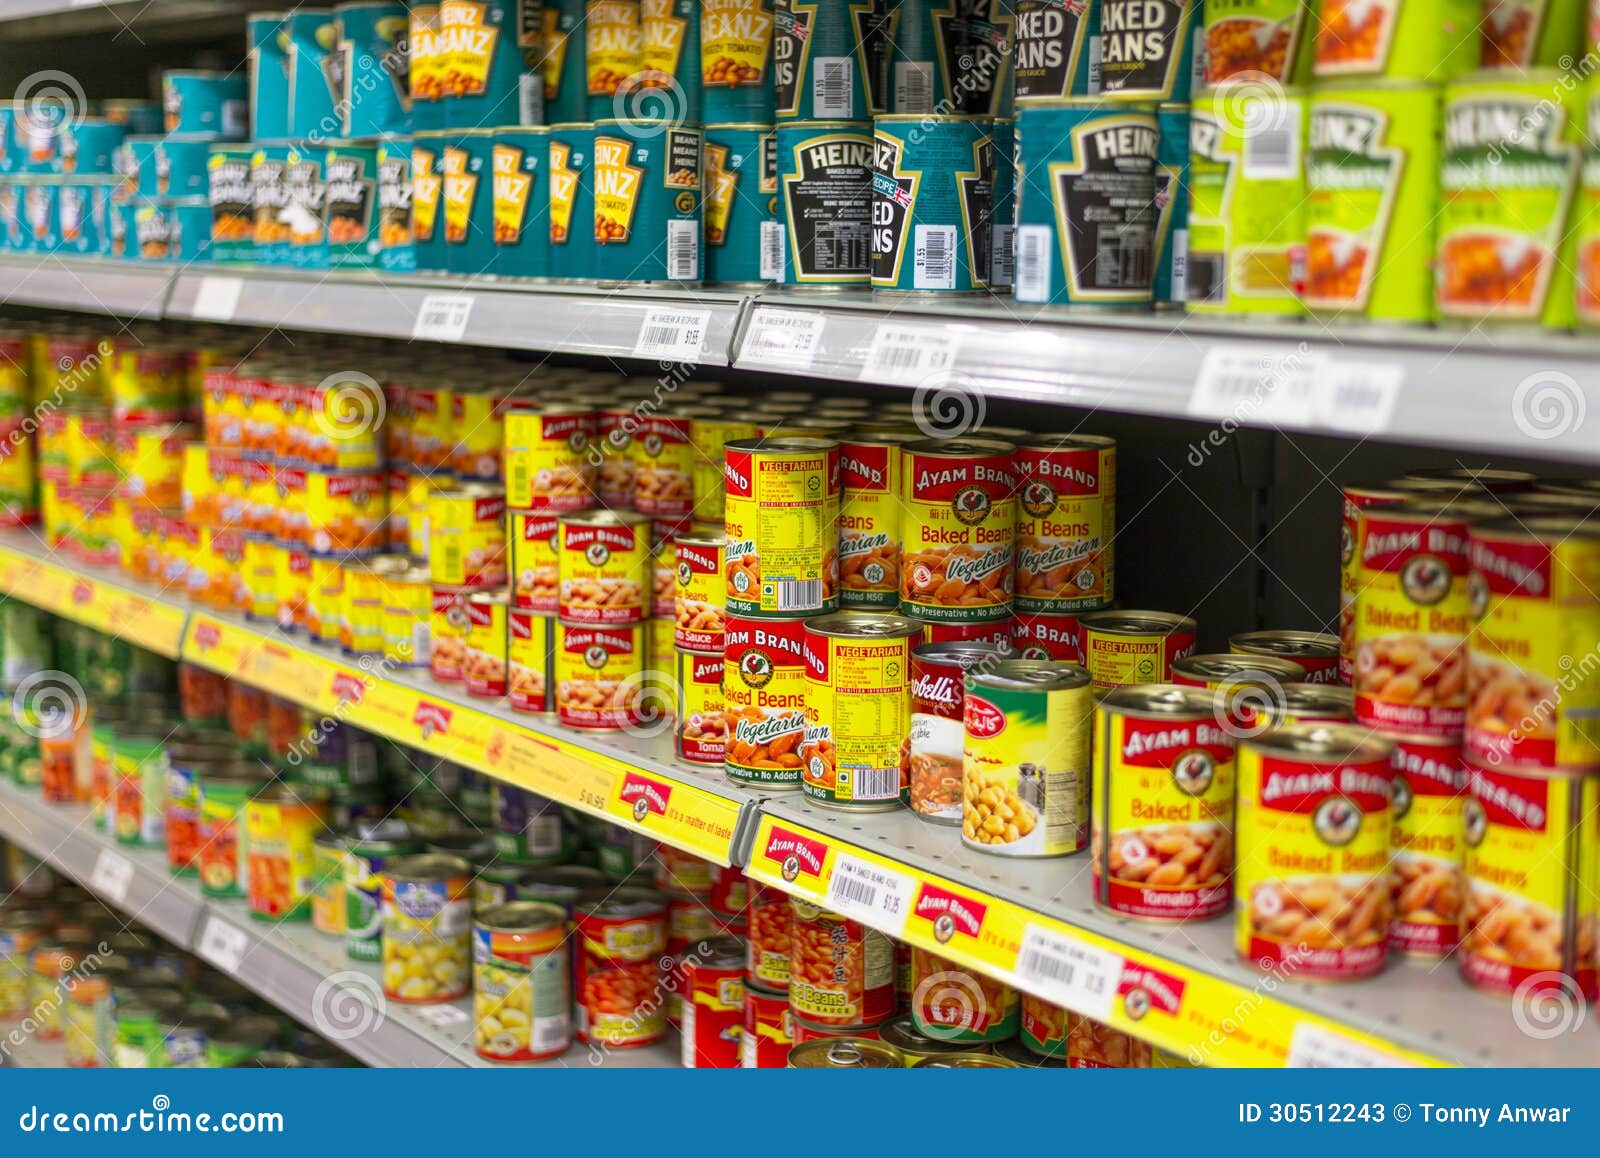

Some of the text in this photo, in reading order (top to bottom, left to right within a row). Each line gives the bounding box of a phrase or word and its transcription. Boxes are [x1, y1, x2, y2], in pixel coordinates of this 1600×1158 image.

[810, 143, 873, 170] HEINZ
[872, 201, 895, 225] ED
[916, 247, 926, 266] $1.55
[763, 461, 822, 472] VEGETARIAN
[1039, 459, 1096, 488] BRAND
[916, 468, 967, 491] AYAM
[921, 525, 1013, 544] Baked Beans
[1041, 520, 1089, 536] Beans
[1016, 536, 1099, 575] Vegetarian
[911, 605, 920, 614] No
[921, 607, 968, 618] Preservative
[977, 609, 988, 617] No
[839, 646, 901, 658] VEGETARIAN
[1095, 640, 1156, 654] VEGETARIAN
[757, 691, 805, 708] Beans
[1124, 728, 1190, 758] AYAM
[760, 770, 798, 780] No Added
[1131, 798, 1192, 821] Baked
[685, 815, 706, 831] matter
[707, 822, 715, 833] of
[714, 825, 732, 840] taste
[768, 838, 795, 853] AYAM
[796, 841, 821, 873] BRAND
[805, 984, 847, 1006] Beans
